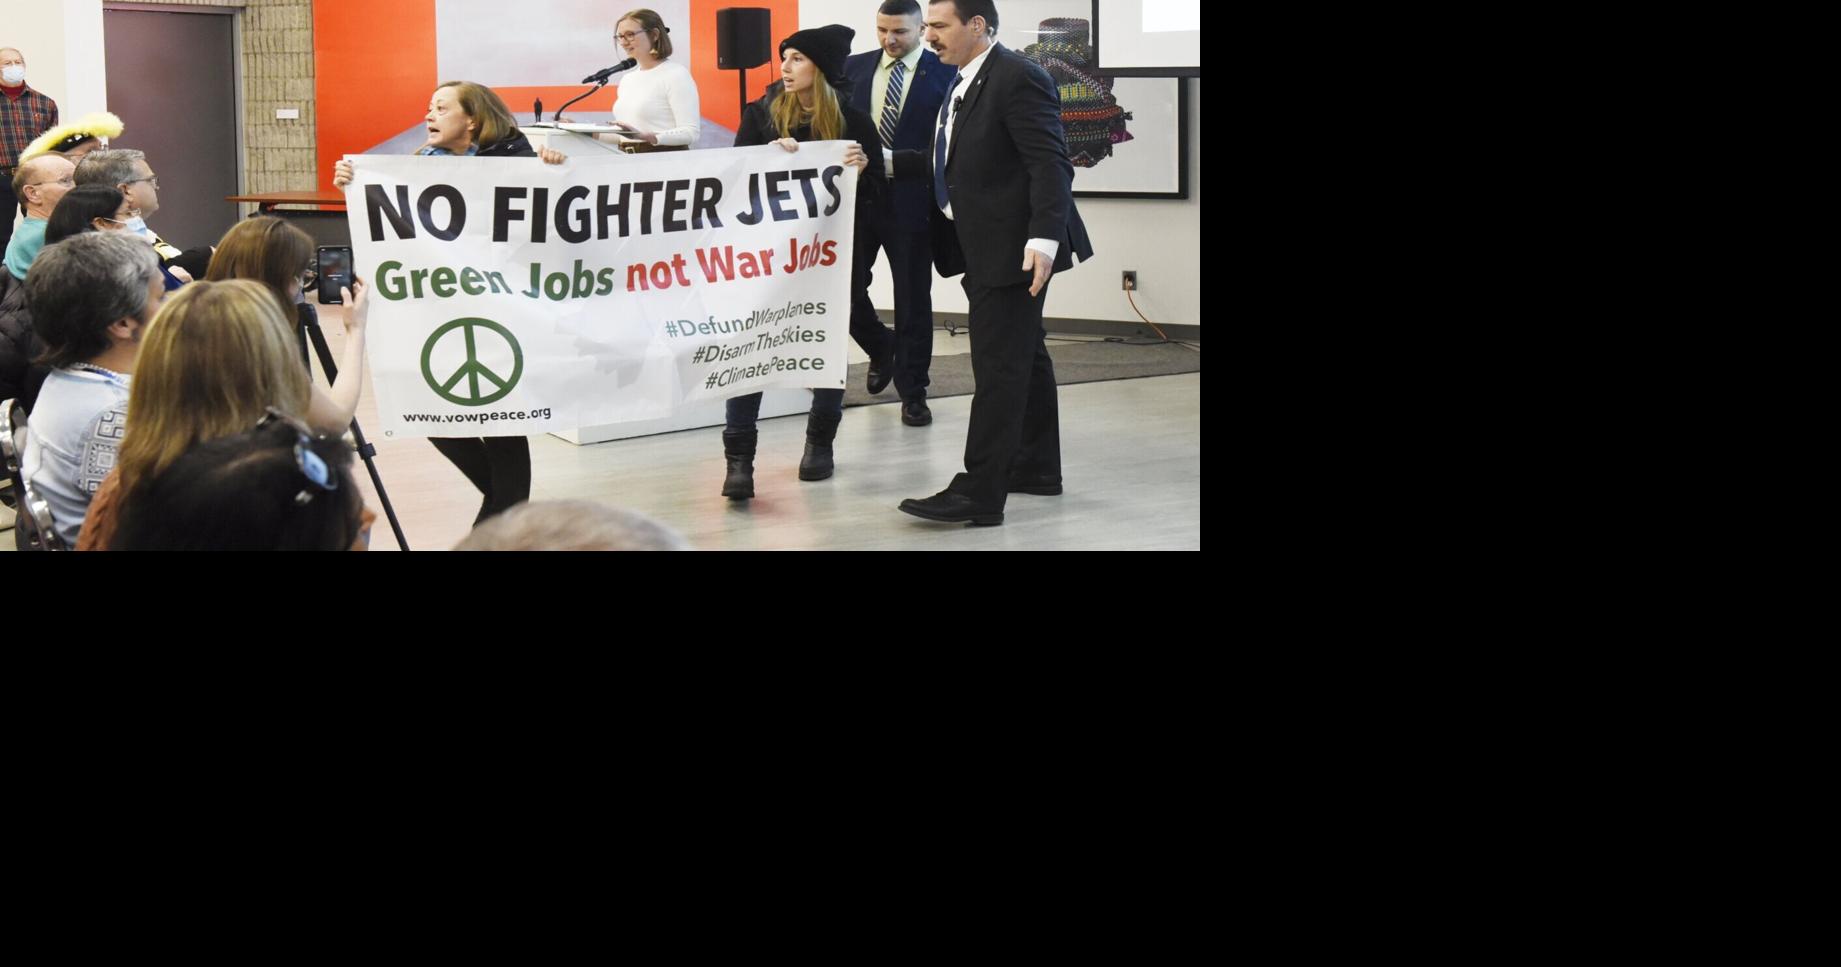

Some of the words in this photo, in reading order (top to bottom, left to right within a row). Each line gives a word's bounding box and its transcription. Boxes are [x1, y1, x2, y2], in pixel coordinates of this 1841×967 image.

[365, 184, 467, 242] NO
[492, 177, 724, 244] FIGHTER
[736, 165, 844, 226] JETS
[375, 260, 513, 301] Green
[521, 259, 616, 301] Jobs
[626, 253, 691, 292] not
[695, 245, 774, 283] War
[783, 232, 838, 276] Jobs
[665, 300, 827, 338] #DefundWarplanes
[692, 325, 826, 364] #DisarmTheSkies
[705, 355, 825, 390] #ClimatePeace
[402, 407, 552, 424] www.vowpeace.org
